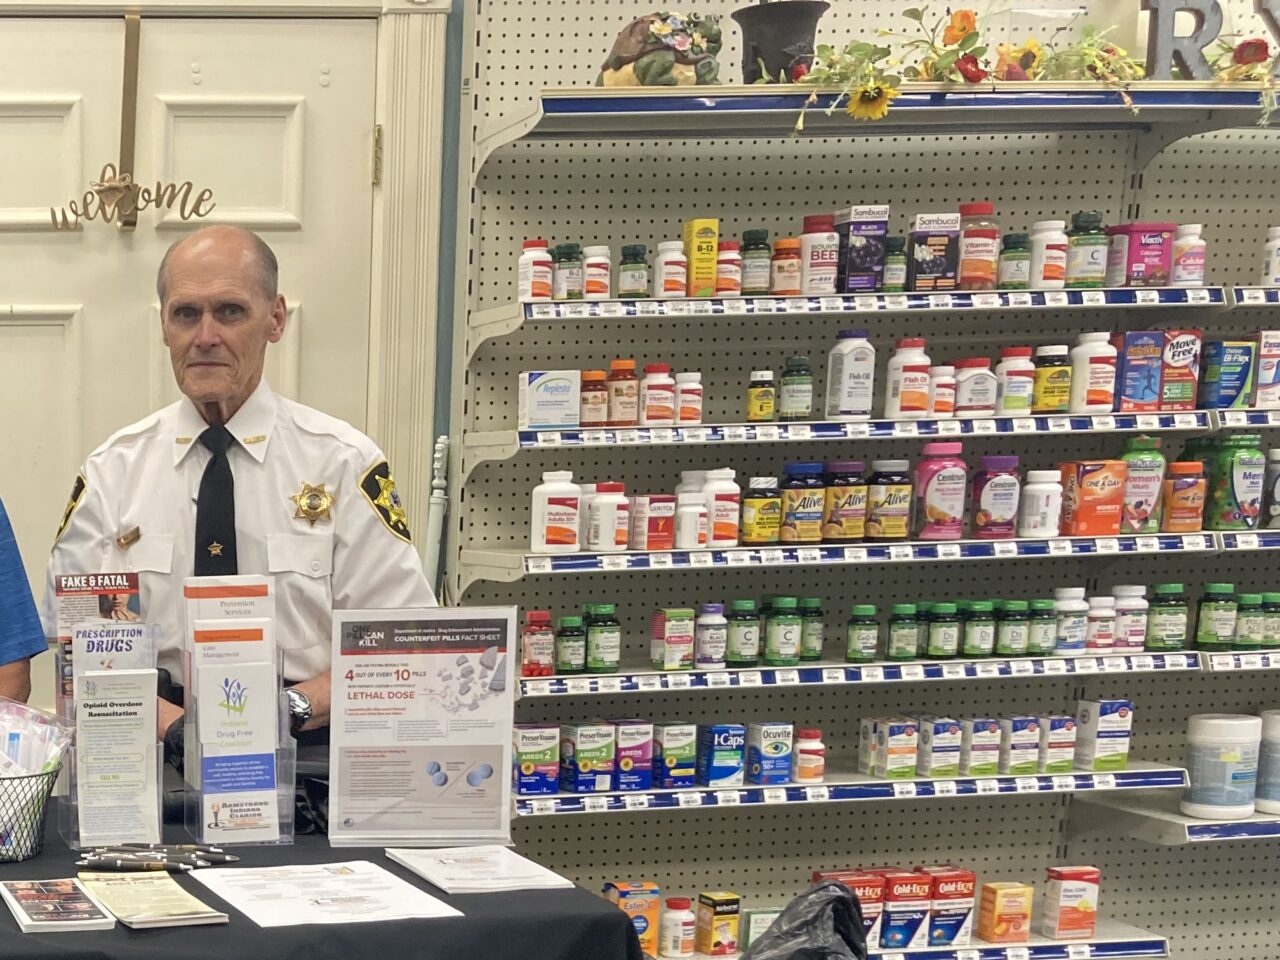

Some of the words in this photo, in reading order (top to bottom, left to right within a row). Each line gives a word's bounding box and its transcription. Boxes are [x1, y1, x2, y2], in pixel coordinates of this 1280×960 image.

[50, 162, 217, 229] welome
[854, 208, 888, 216] Sambucol
[919, 217, 959, 225] Sambucol
[1090, 250, 1100, 260] C
[1169, 338, 1197, 351] Move
[1171, 348, 1193, 360] Free
[1224, 354, 1249, 362] Bi-Flex
[795, 497, 823, 511] Alive
[880, 494, 909, 508] Alive
[649, 504, 673, 512] GERITOL
[62, 576, 87, 587] FAKE
[89, 576, 96, 586] &
[98, 575, 129, 586] FATAL
[76, 628, 142, 639] PRESCRIPTION
[395, 634, 440, 642] COUNTERFEIT
[744, 632, 752, 641] C
[784, 631, 792, 641] C
[86, 640, 133, 652] DRUGS
[345, 670, 354, 681] 4
[394, 669, 410, 681] 10
[348, 692, 384, 700] LETHAL
[388, 691, 415, 699] DOSE
[763, 730, 791, 739] Ocuvite
[544, 751, 551, 759] 2
[601, 749, 607, 757] 2
[716, 904, 739, 912] Airborne
